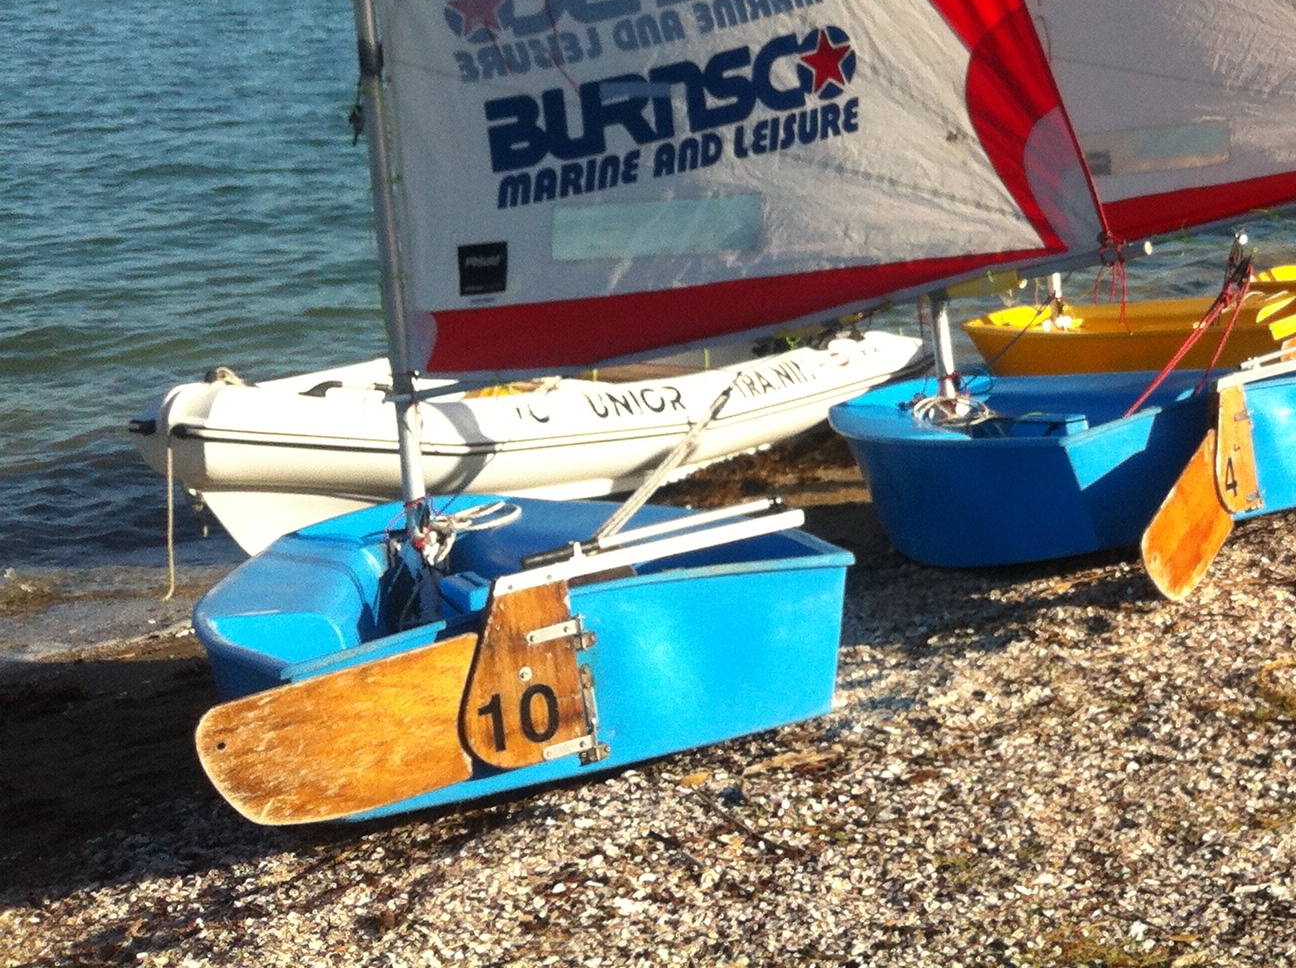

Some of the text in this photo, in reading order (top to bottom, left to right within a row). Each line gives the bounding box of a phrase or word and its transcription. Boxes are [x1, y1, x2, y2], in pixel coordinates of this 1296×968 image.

[484, 25, 857, 173] BURNSCO
[497, 96, 861, 210] MARINE AND LEISURE
[1224, 456, 1238, 498] 4
[475, 683, 560, 754] 10
